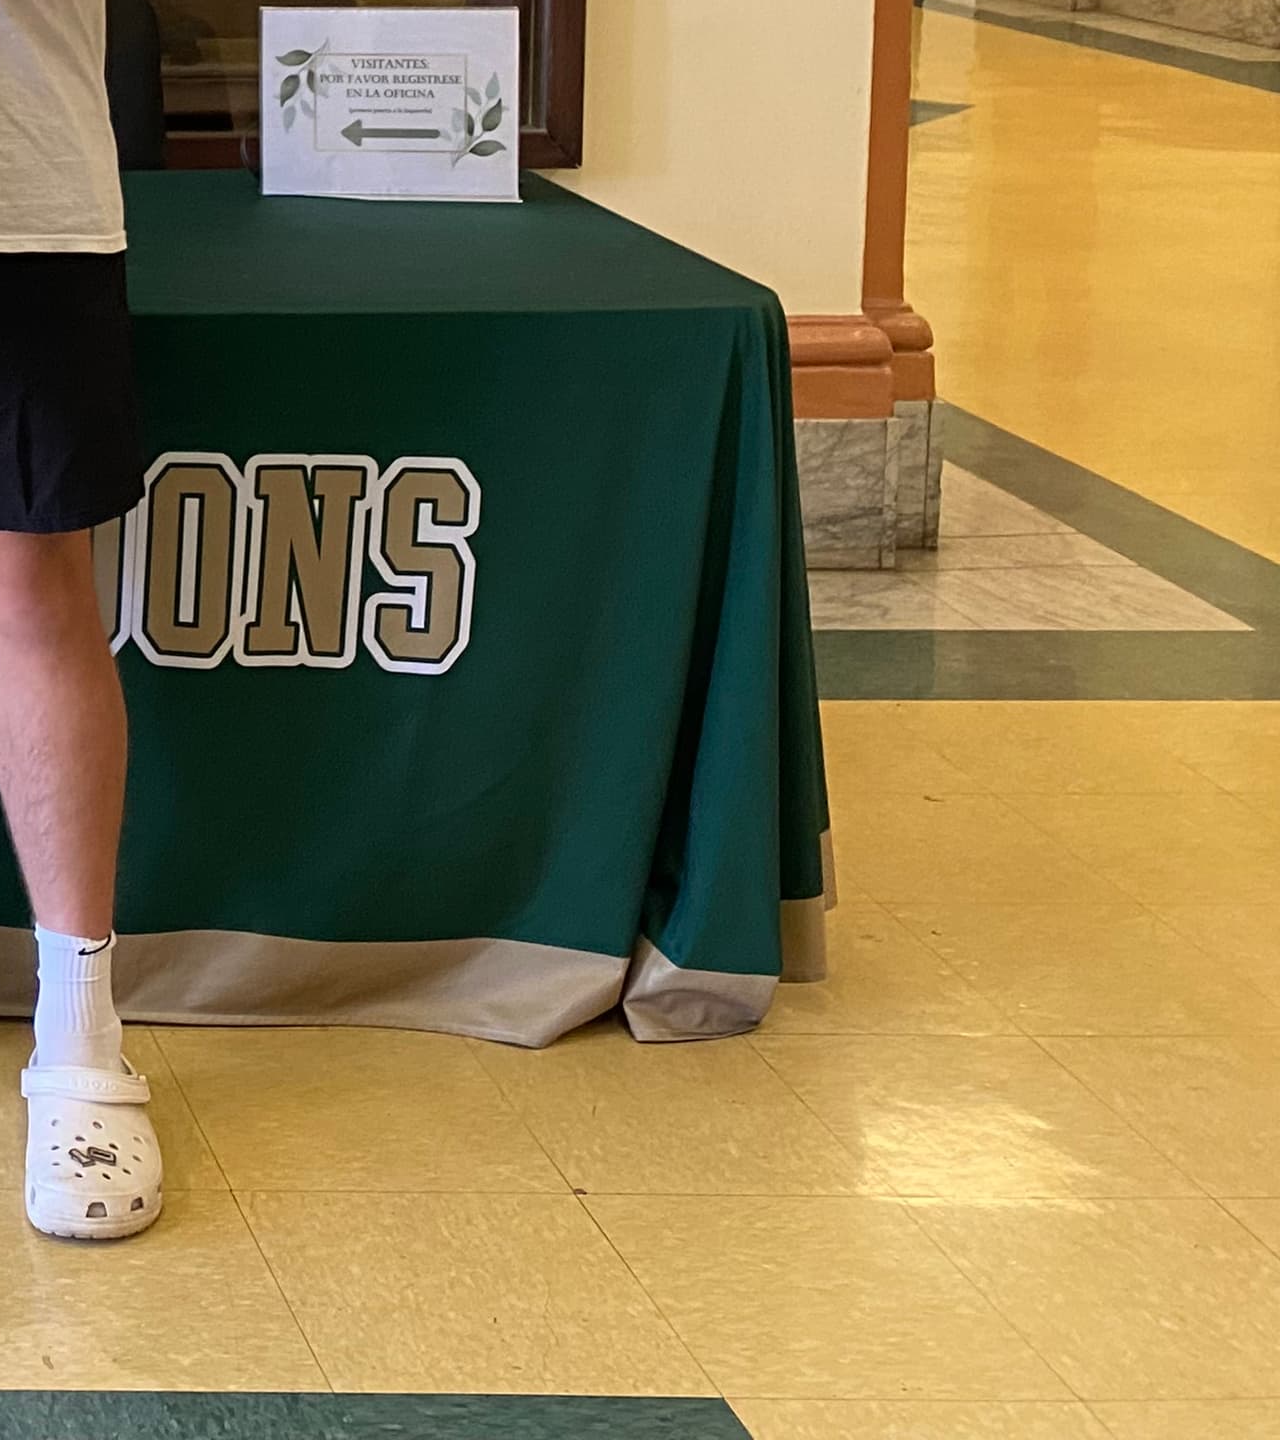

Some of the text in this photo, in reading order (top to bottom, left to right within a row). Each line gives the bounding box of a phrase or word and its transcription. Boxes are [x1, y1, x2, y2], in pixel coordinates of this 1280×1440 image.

[320, 74, 462, 85] POR FAVOR REGISTRESE
[346, 88, 435, 99] EN LA OFICINA
[92, 451, 482, 674] ONS
